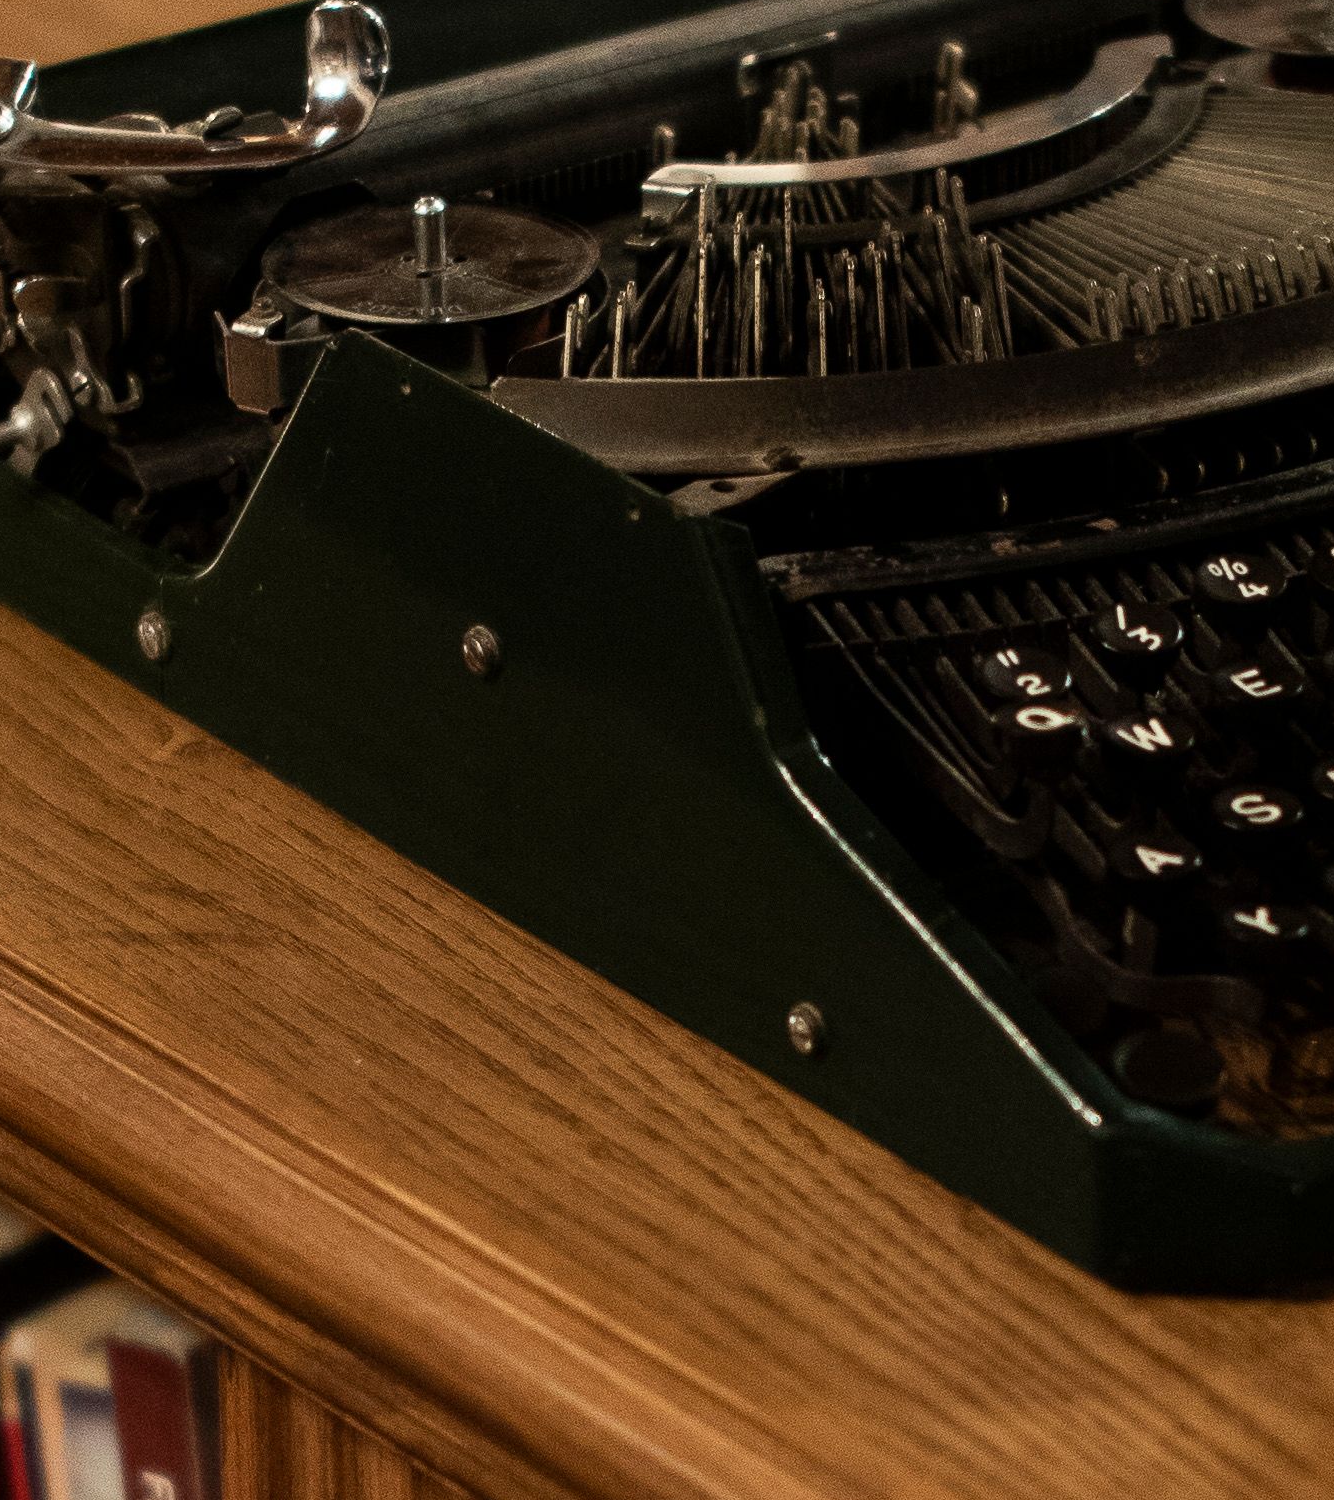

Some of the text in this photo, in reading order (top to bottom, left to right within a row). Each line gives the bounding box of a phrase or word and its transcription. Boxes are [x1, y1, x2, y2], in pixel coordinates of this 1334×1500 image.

[1207, 556, 1250, 582] %
[1015, 673, 1054, 697] 2
[1127, 627, 1164, 653] 3
[1238, 582, 1271, 599] 4
[1117, 717, 1175, 752] W
[1230, 667, 1284, 699] E
[1134, 843, 1185, 876] A
[1229, 791, 1284, 825] S
[1232, 904, 1283, 937] Y
